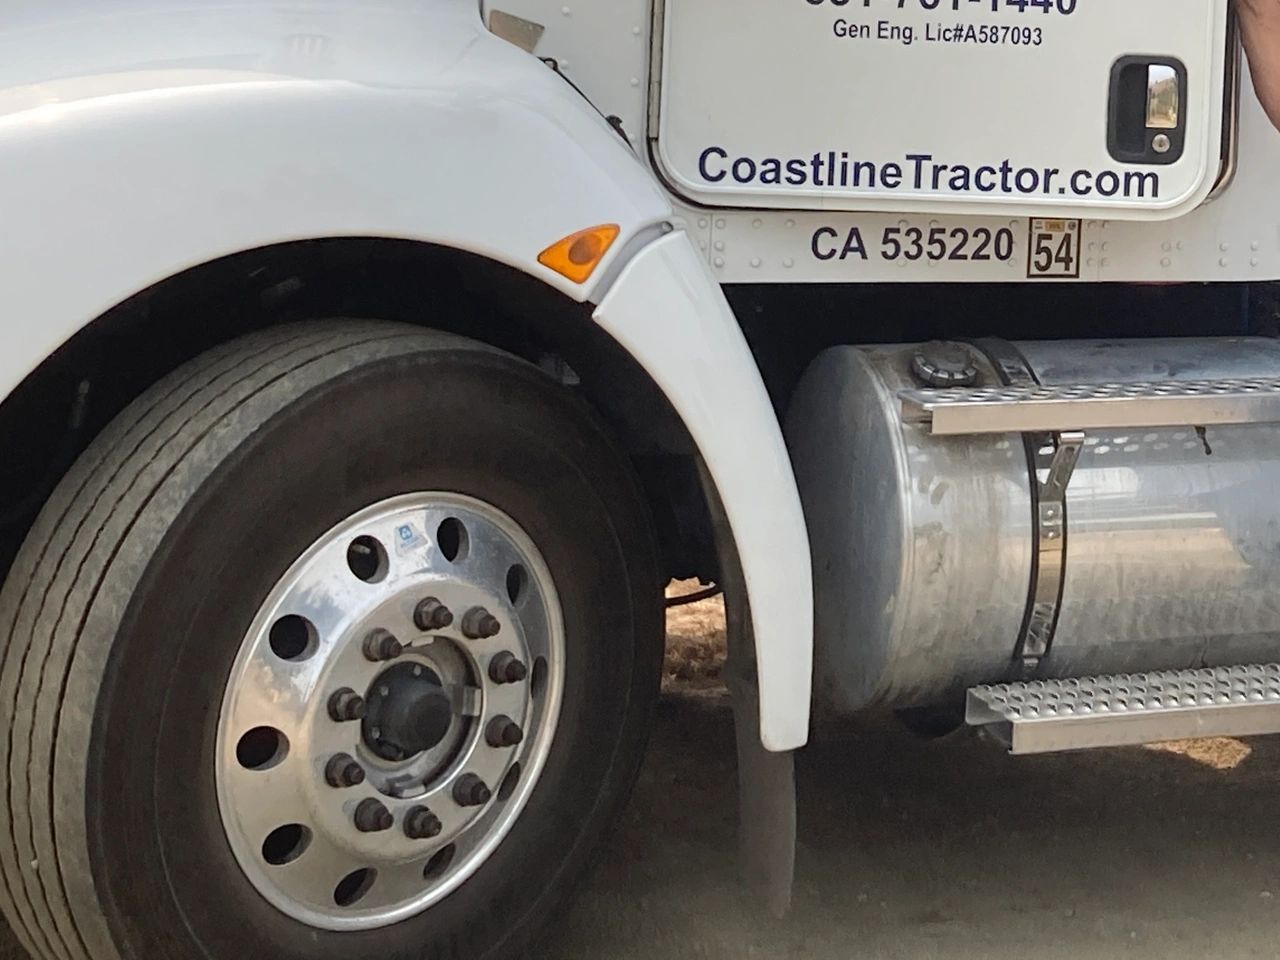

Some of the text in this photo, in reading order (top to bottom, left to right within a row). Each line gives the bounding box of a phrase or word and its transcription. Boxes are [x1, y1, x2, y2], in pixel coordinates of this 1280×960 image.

[833, 19, 870, 38] Gen
[878, 21, 918, 45] Eng.
[698, 147, 1159, 198] CoastlineTractor.com
[812, 227, 1013, 260] CA 535220
[1034, 233, 1073, 272] 54
